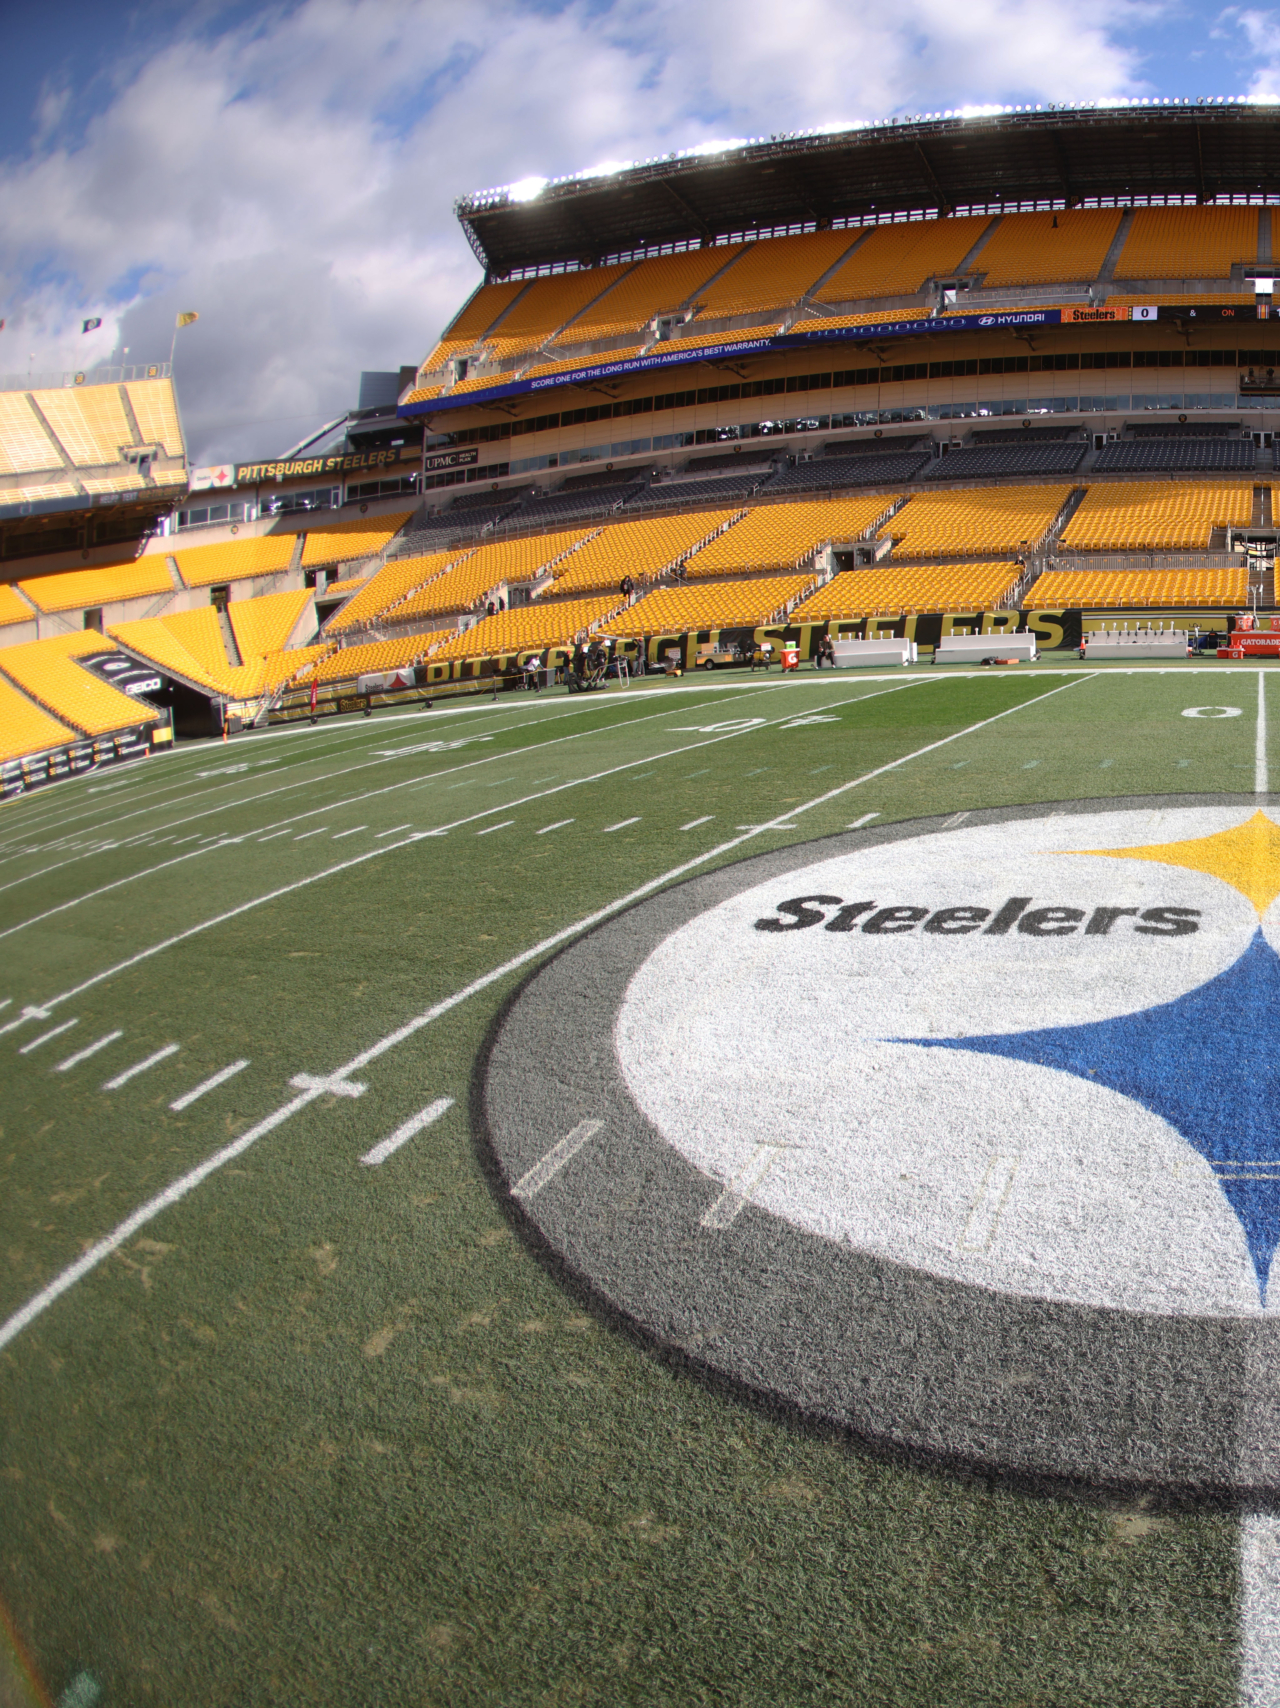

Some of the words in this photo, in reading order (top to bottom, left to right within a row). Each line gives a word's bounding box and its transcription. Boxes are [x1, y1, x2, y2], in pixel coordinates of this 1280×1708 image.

[998, 313, 1045, 324] HYUNDAI
[1072, 309, 1116, 321] Steelers
[1140, 308, 1149, 318] 0
[1221, 309, 1235, 317] ON
[531, 378, 556, 389] SCORE
[556, 374, 571, 384] ONE
[572, 371, 587, 381] FOR
[587, 368, 601, 378] THE
[602, 364, 622, 375] LONG
[624, 361, 640, 370] RUN
[641, 357, 661, 368] WITH
[662, 348, 703, 364] AMERICA'S
[704, 345, 723, 357] BEST
[724, 339, 771, 352] WARRANTY.
[238, 459, 323, 480] PITTSBURGH
[325, 449, 396, 471] STEELERS
[427, 454, 457, 468] UPMC
[787, 653, 798, 663] G
[125, 678, 161, 695] GEICO
[365, 683, 384, 692] Steelers
[340, 699, 368, 712] Steelers
[754, 895, 1201, 937] Steelers
